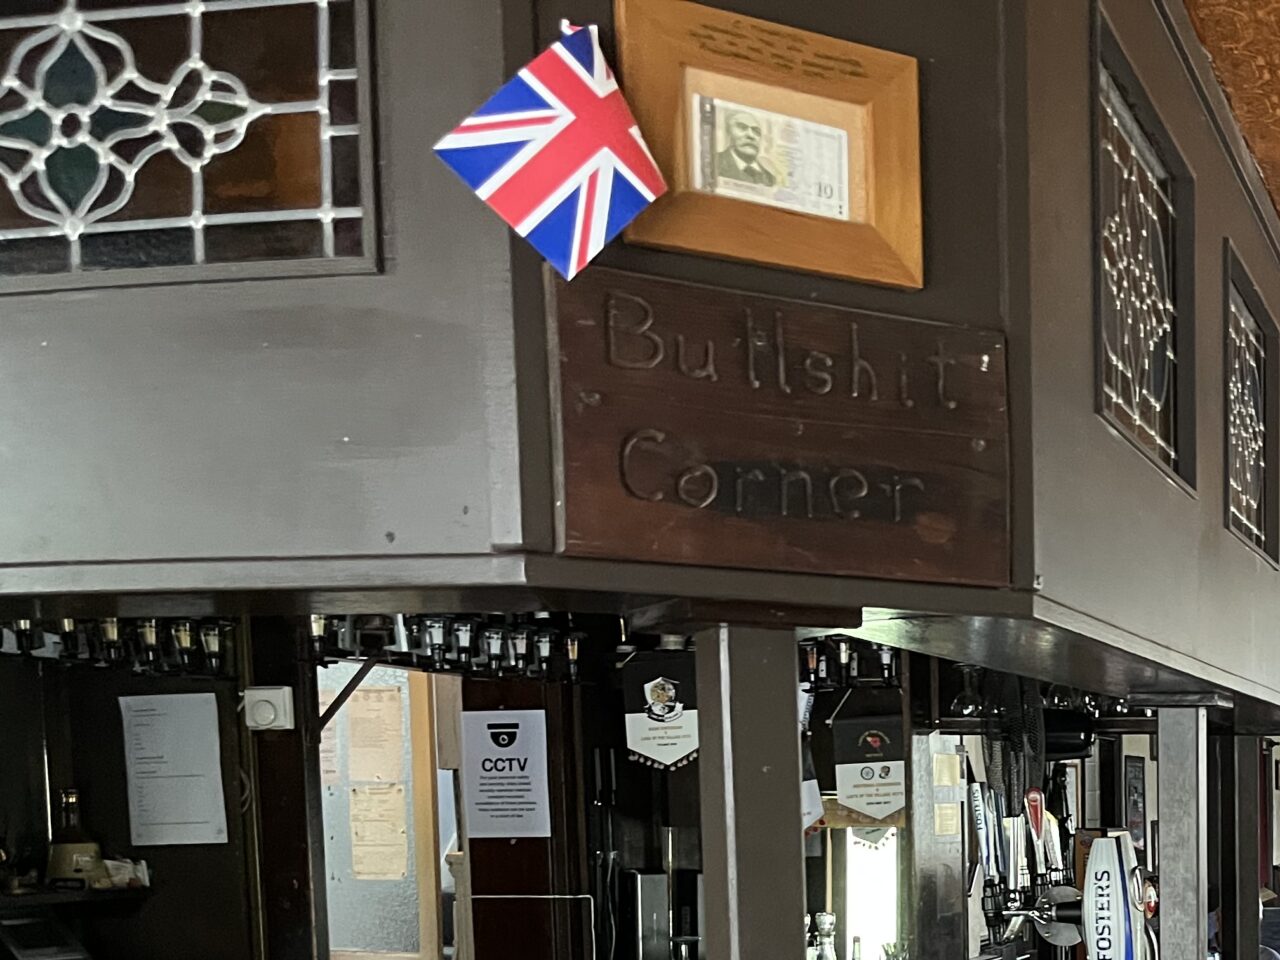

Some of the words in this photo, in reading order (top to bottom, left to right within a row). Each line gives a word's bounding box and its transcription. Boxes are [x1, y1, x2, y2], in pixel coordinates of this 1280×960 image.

[606, 289, 957, 409] Bullshit
[620, 428, 925, 522] Corner
[481, 757, 529, 773] CCTV
